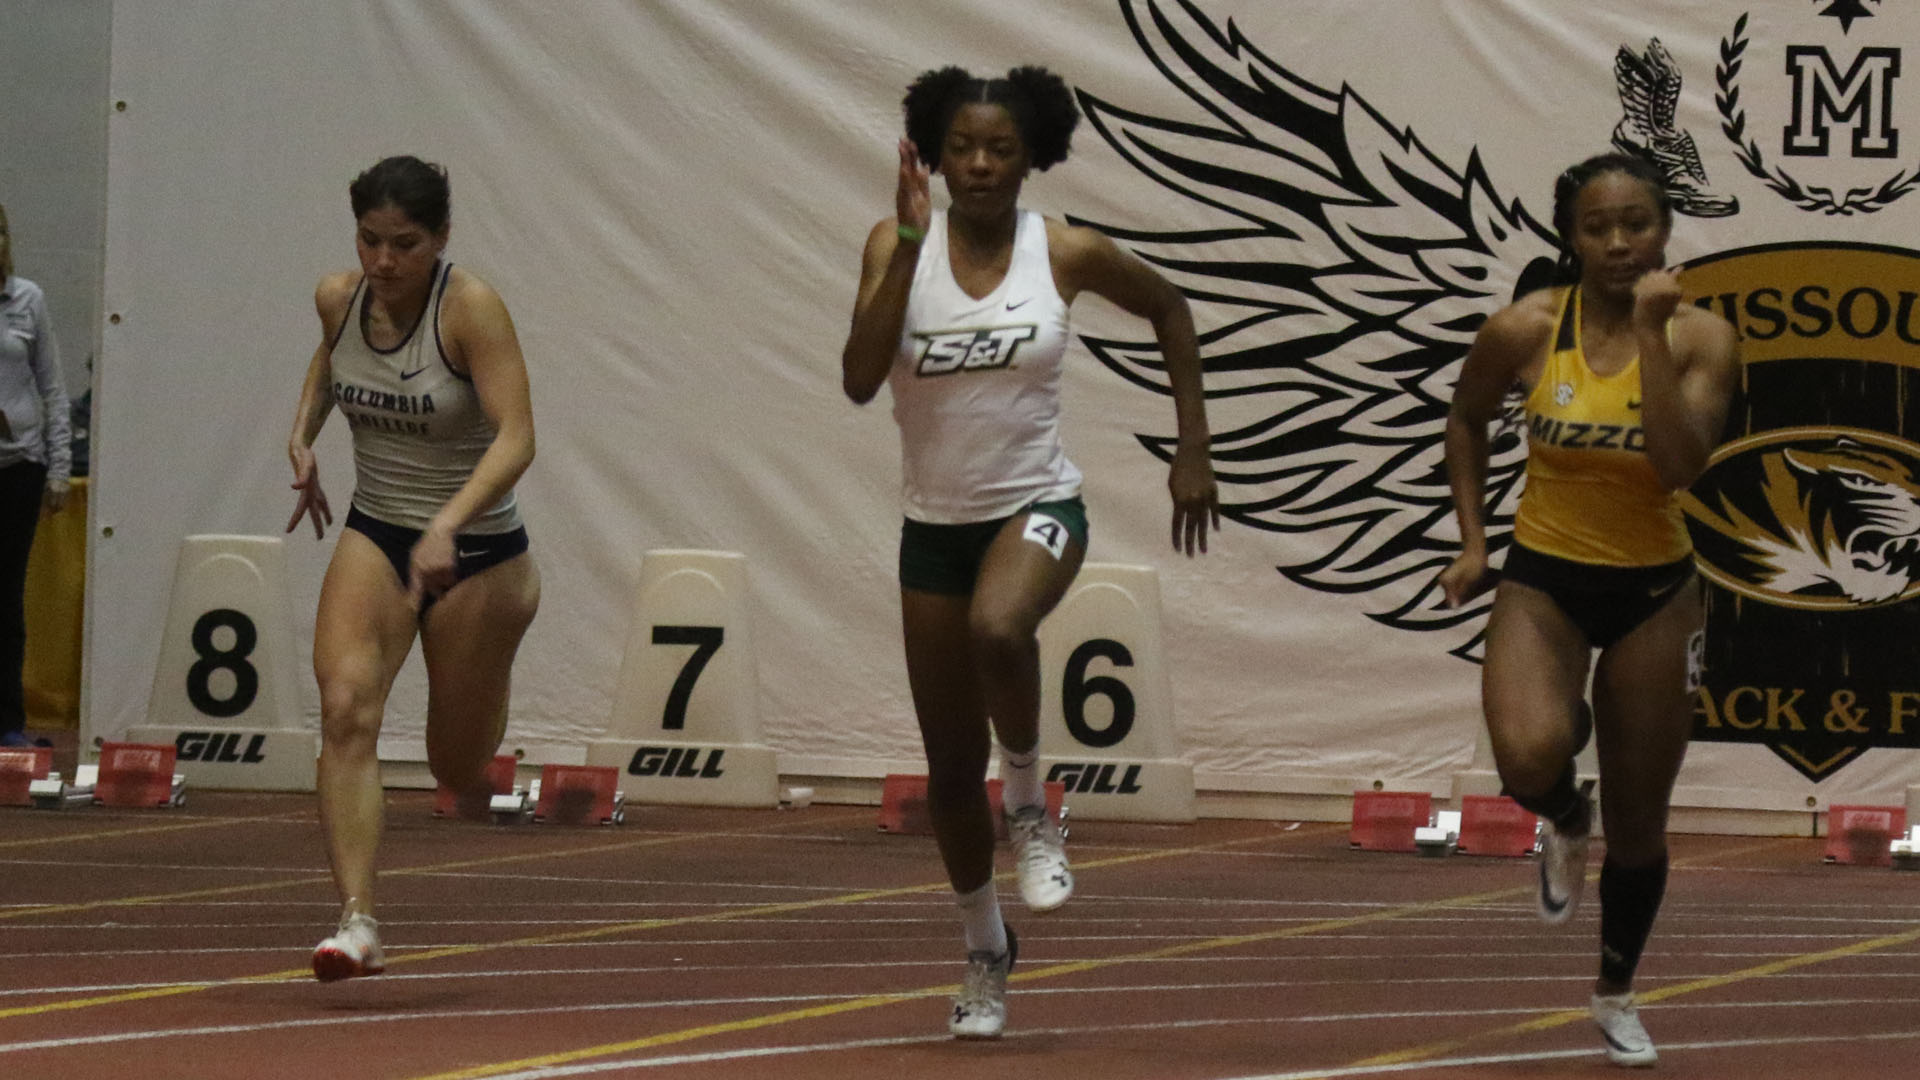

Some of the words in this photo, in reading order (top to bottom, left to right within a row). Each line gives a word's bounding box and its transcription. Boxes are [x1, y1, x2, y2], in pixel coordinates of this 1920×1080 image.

[1782, 45, 1902, 158] M
[911, 325, 1038, 377] S&T
[335, 382, 435, 415] COLUMBIA
[1532, 414, 1647, 452] MIZZO
[1032, 521, 1061, 548] 4
[186, 608, 258, 717] 8
[651, 625, 724, 729] 7
[1062, 638, 1136, 748] 6
[1694, 685, 1807, 731] ACK
[1823, 689, 1869, 733] &
[175, 732, 266, 763] GILL
[627, 747, 725, 778] GILL
[1045, 763, 1142, 794] GILL
